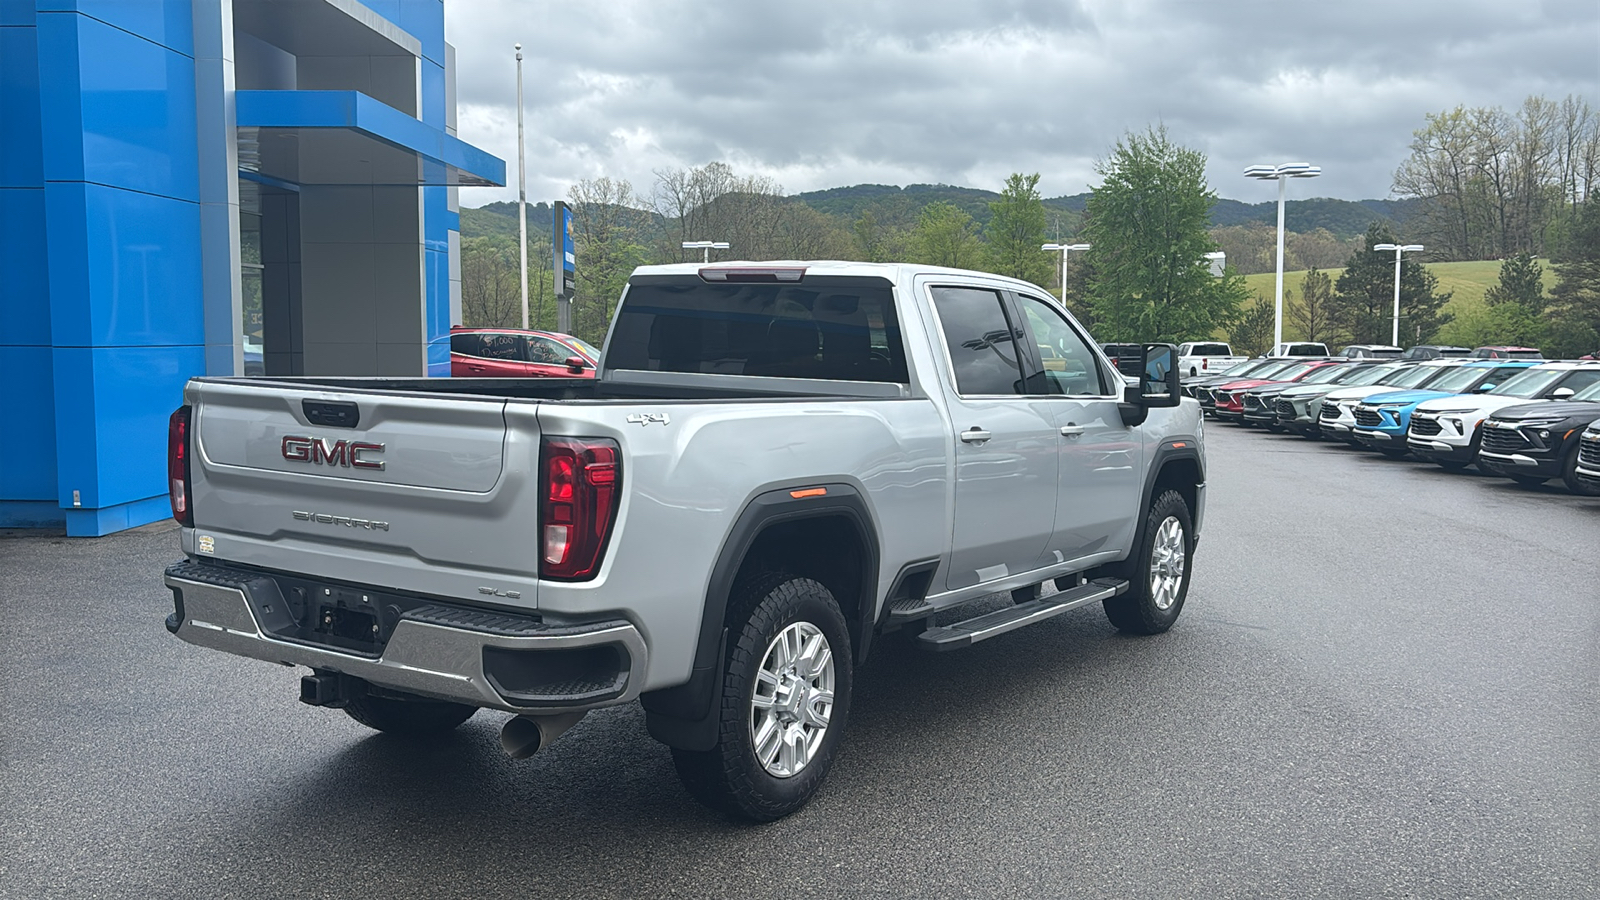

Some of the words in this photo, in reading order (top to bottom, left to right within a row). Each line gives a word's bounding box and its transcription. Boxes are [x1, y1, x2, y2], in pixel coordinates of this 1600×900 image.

[281, 435, 386, 471] GMC
[292, 510, 390, 532] SIERRA
[478, 586, 521, 599] SLE
